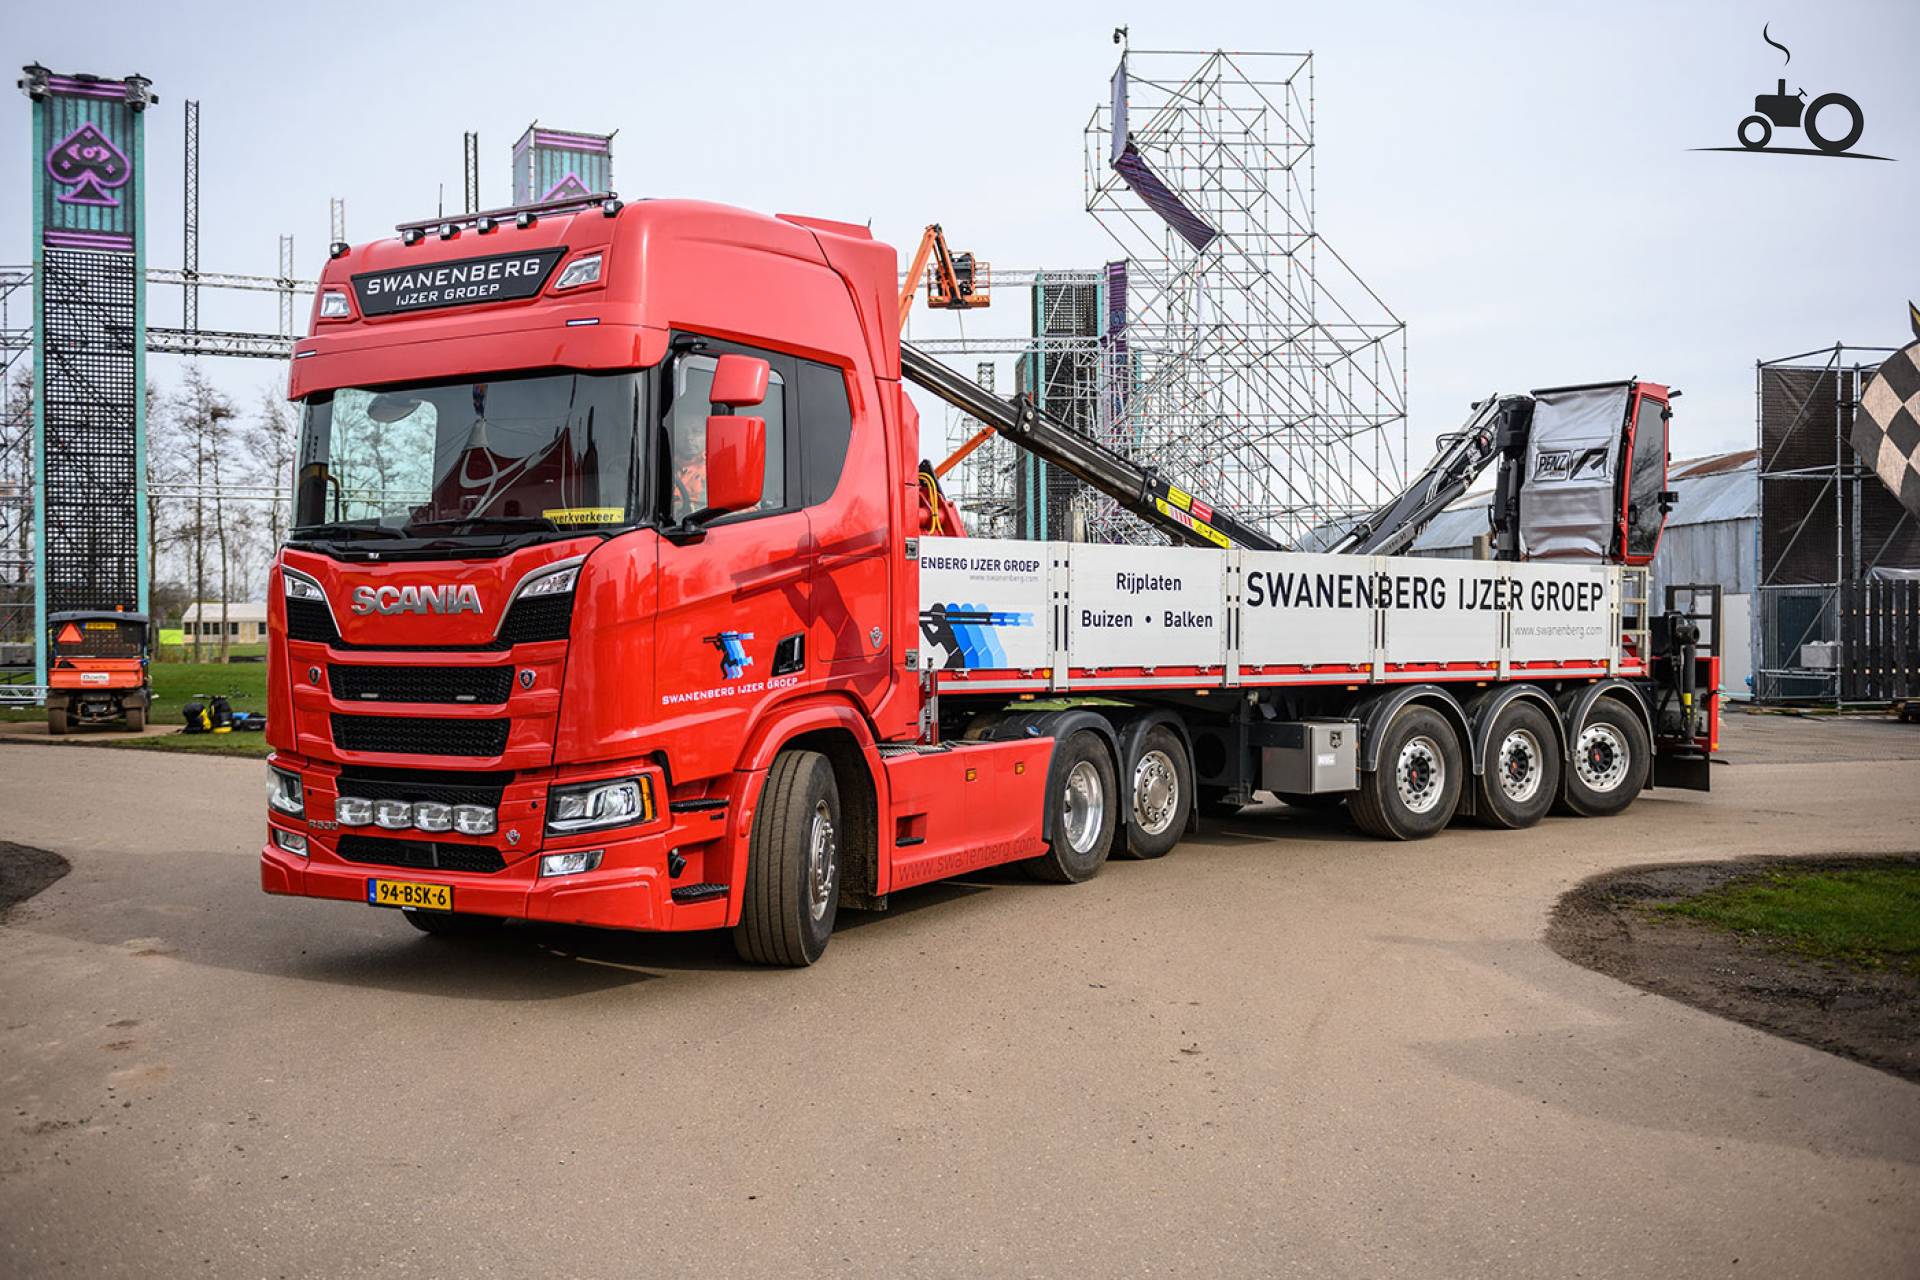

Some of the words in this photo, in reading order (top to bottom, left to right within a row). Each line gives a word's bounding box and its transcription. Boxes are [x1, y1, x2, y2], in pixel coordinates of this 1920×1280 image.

[366, 258, 541, 295] SWANENBERG
[395, 290, 439, 306] IJZER
[443, 283, 500, 300] GROEP
[970, 558, 1000, 571] IJZER
[1003, 559, 1040, 572] GROEP
[1116, 572, 1182, 594] Rijplaten
[1246, 571, 1446, 610] SWANENBERG
[1458, 577, 1524, 611] IJZER
[1531, 580, 1603, 611] GROEP
[351, 584, 484, 615] SCANIA
[1081, 610, 1133, 628] Buizen
[1163, 610, 1213, 628] Balken
[1513, 624, 1603, 640] www.swanenberg.com
[662, 686, 735, 705] SWANENBERG
[738, 682, 765, 693] IJZER
[767, 677, 798, 689] GROEP
[900, 836, 1037, 881] www.swanenberg.com
[380, 883, 447, 906] 94-BSK-6
